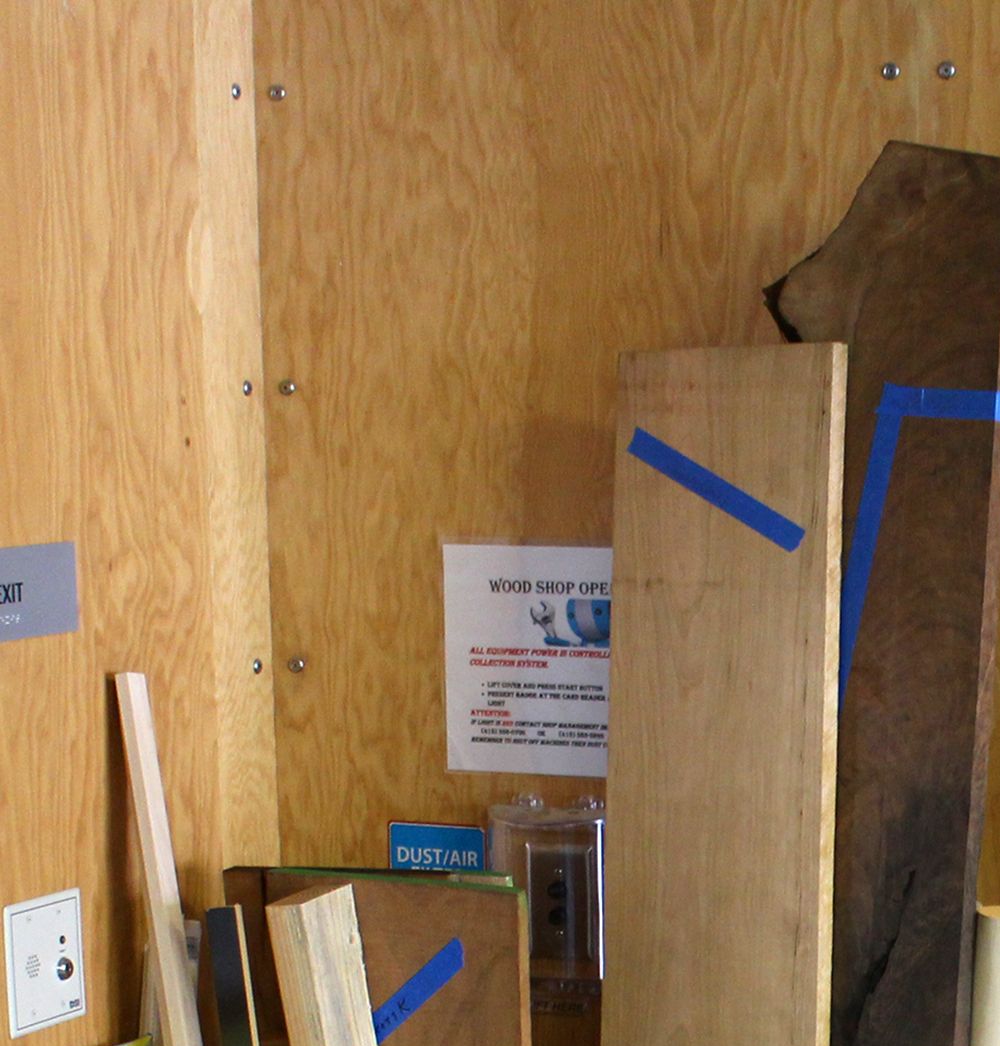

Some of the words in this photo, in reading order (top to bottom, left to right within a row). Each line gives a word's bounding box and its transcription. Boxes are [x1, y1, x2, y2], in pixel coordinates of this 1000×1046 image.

[489, 578, 532, 593] WOOD
[536, 580, 575, 595] SHOP
[579, 581, 611, 596] OPE
[486, 647, 530, 656] EQUIPMENT
[531, 648, 559, 657] POWER
[470, 659, 515, 668] COLLECTION
[396, 846, 478, 867] DUST/AIR
